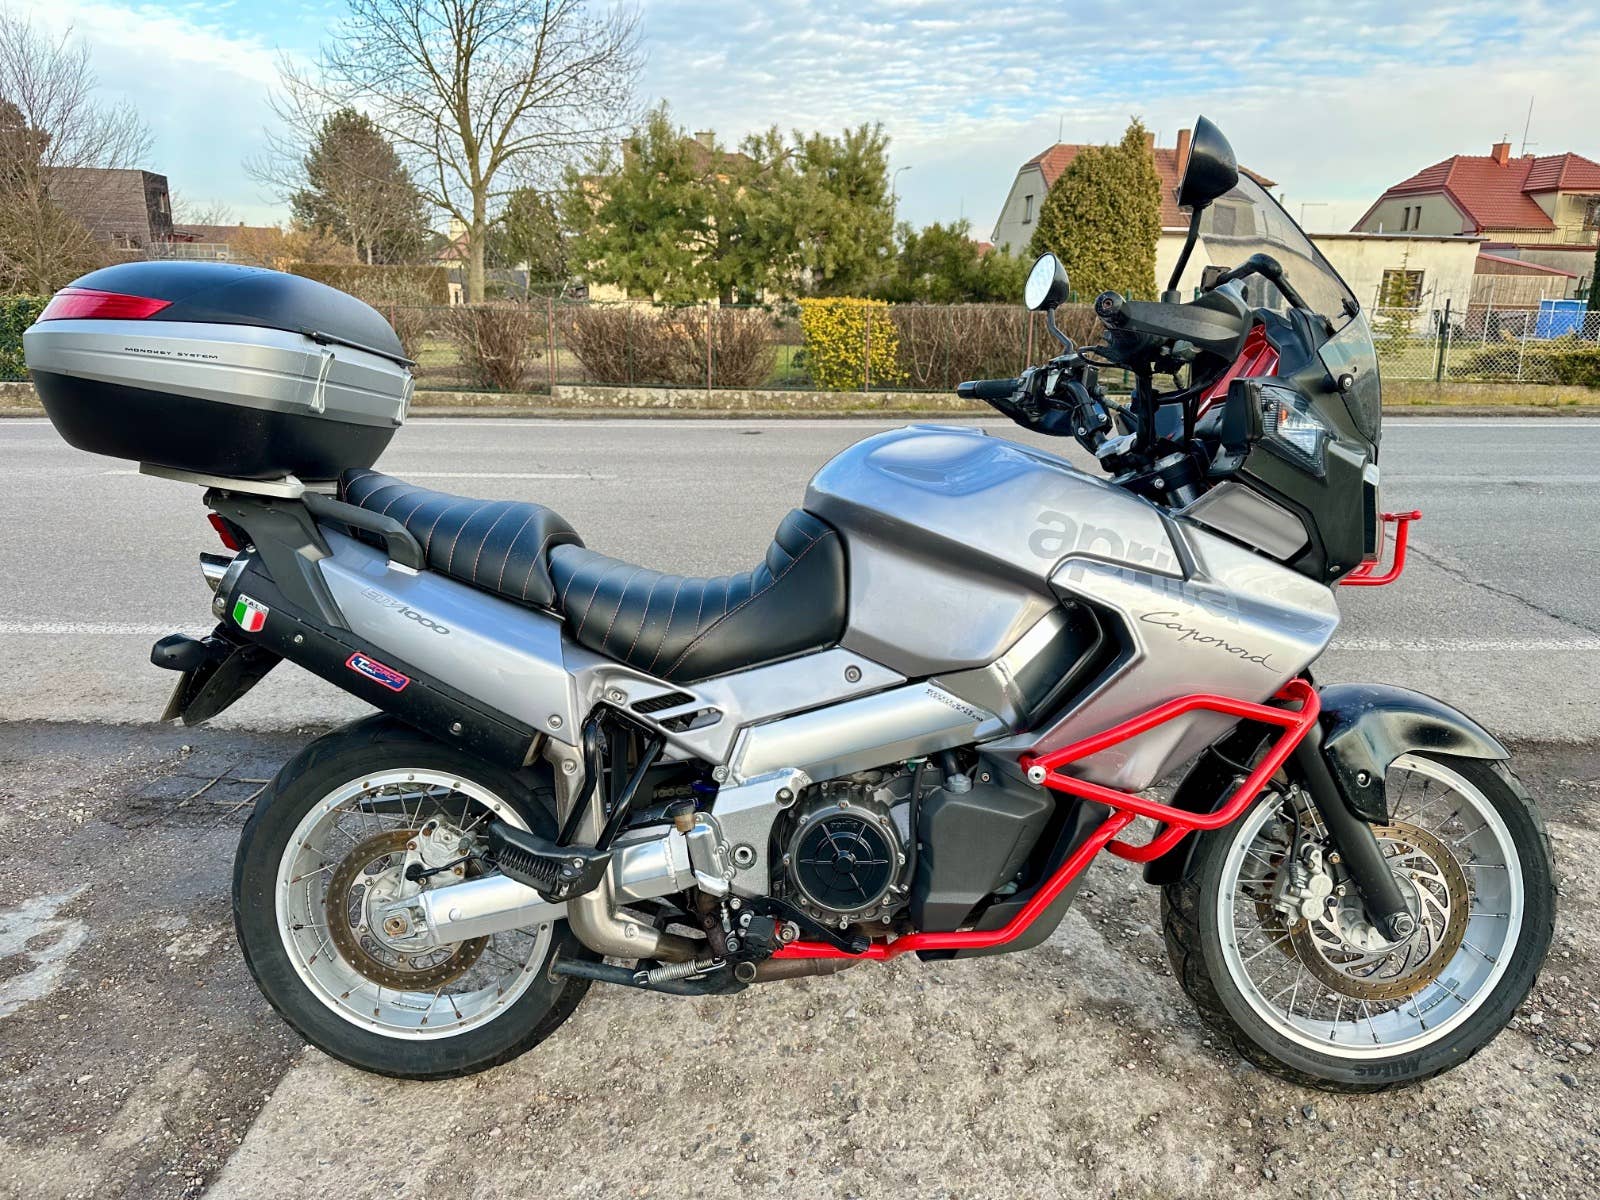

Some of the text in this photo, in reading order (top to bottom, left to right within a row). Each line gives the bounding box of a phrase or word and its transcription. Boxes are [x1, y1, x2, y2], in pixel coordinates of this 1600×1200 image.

[124, 346, 219, 360] MONOKEY SYSTEM
[1028, 510, 1240, 624] aprilia
[1139, 611, 1282, 674] Caponord
